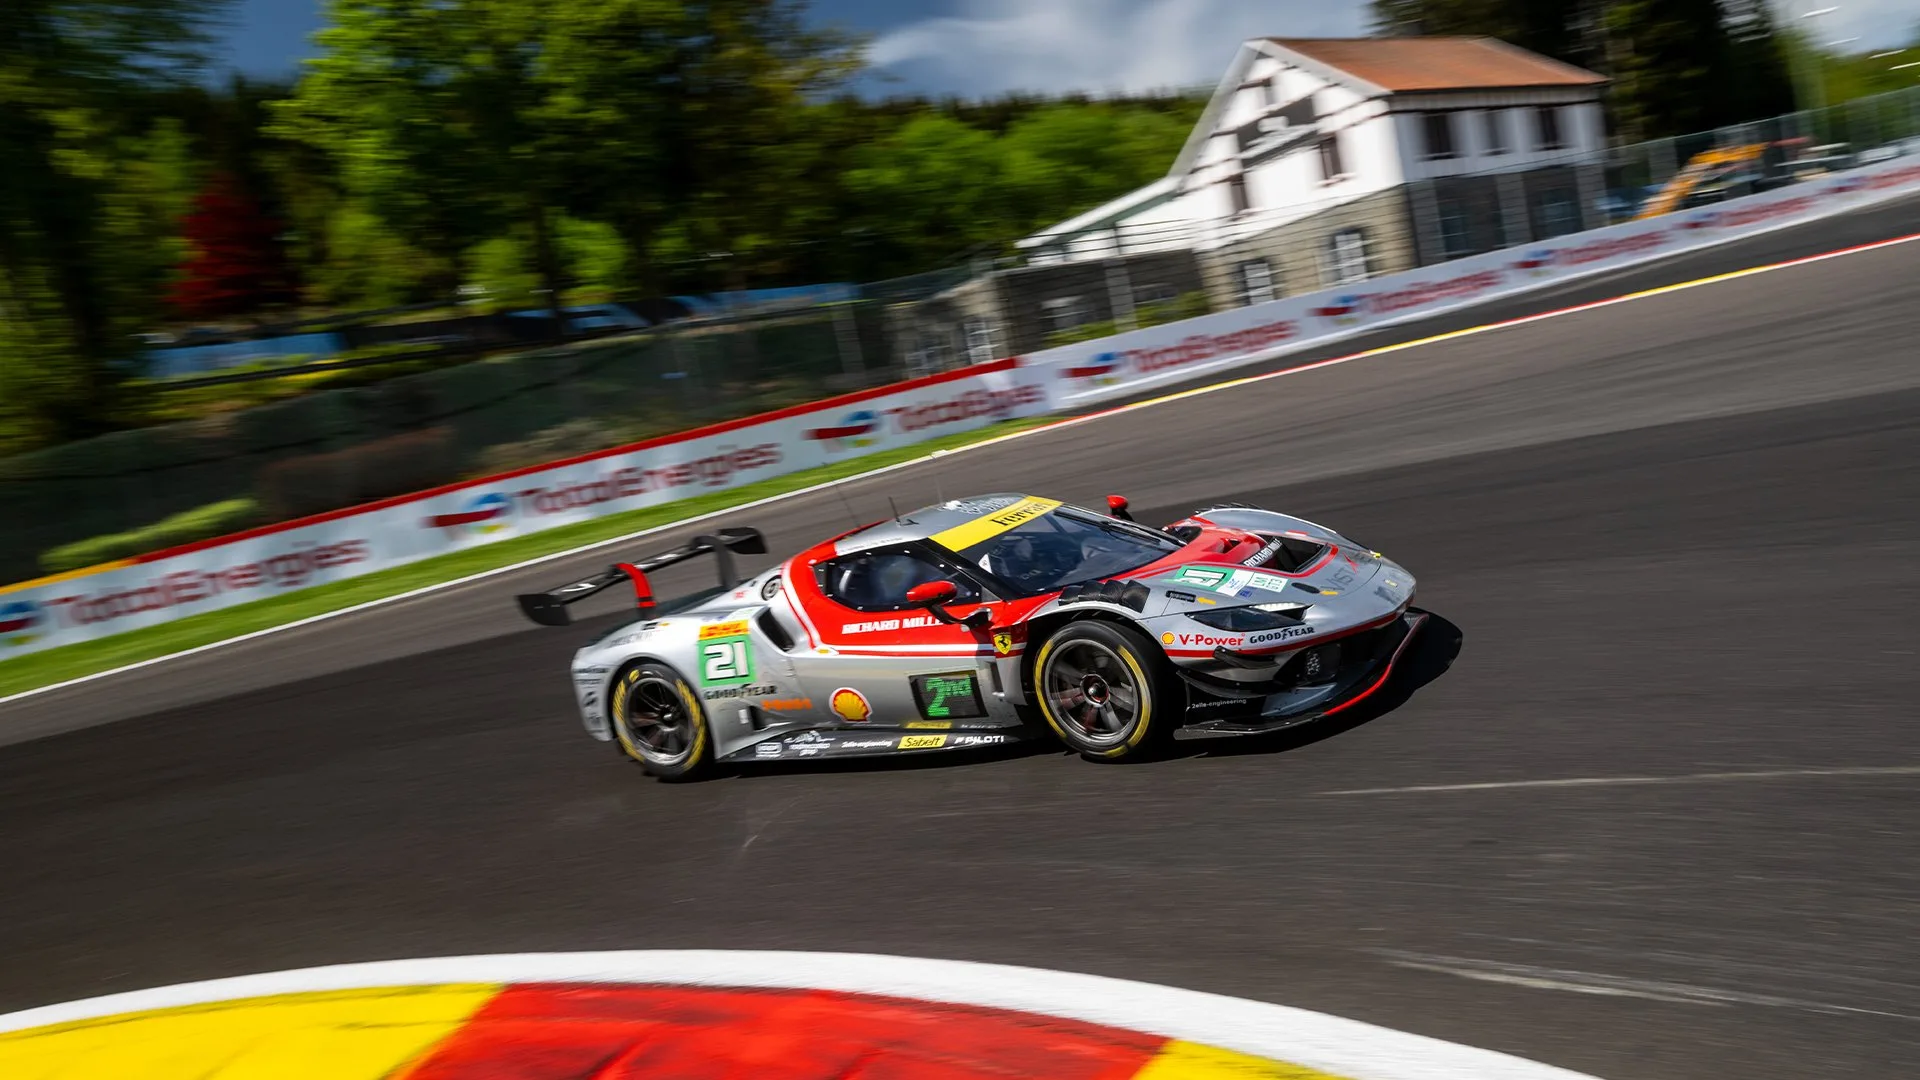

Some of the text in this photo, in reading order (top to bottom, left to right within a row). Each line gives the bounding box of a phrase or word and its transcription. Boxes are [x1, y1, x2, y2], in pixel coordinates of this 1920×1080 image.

[841, 618, 900, 635] RICHARD
[1249, 625, 1315, 644] GOODYEAR
[1178, 633, 1244, 647] V-Power
[703, 640, 749, 681] 21
[925, 674, 973, 717] 2nd
[904, 736, 941, 748] Sabelt
